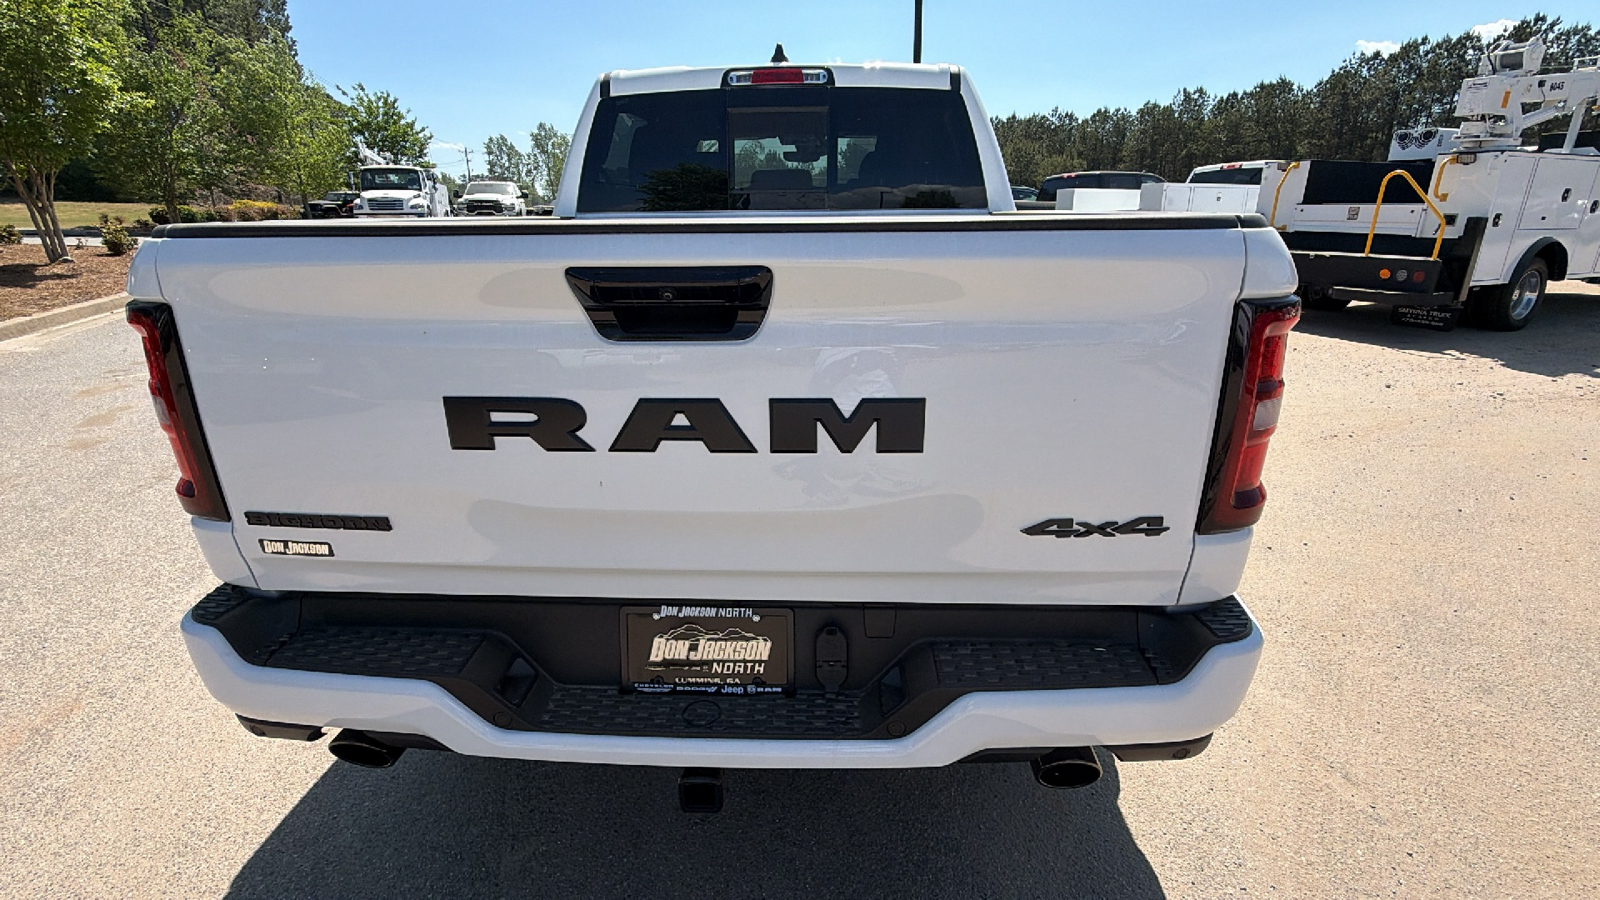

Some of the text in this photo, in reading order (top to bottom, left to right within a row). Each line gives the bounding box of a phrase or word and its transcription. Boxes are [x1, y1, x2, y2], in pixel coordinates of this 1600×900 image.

[442, 396, 927, 454] RAM
[263, 540, 285, 554] DON
[660, 605, 753, 618] DON JACKSON NORTH
[648, 637, 772, 662] DON JACKSON
[711, 662, 765, 674] NORTH
[721, 685, 744, 694] Jeep
